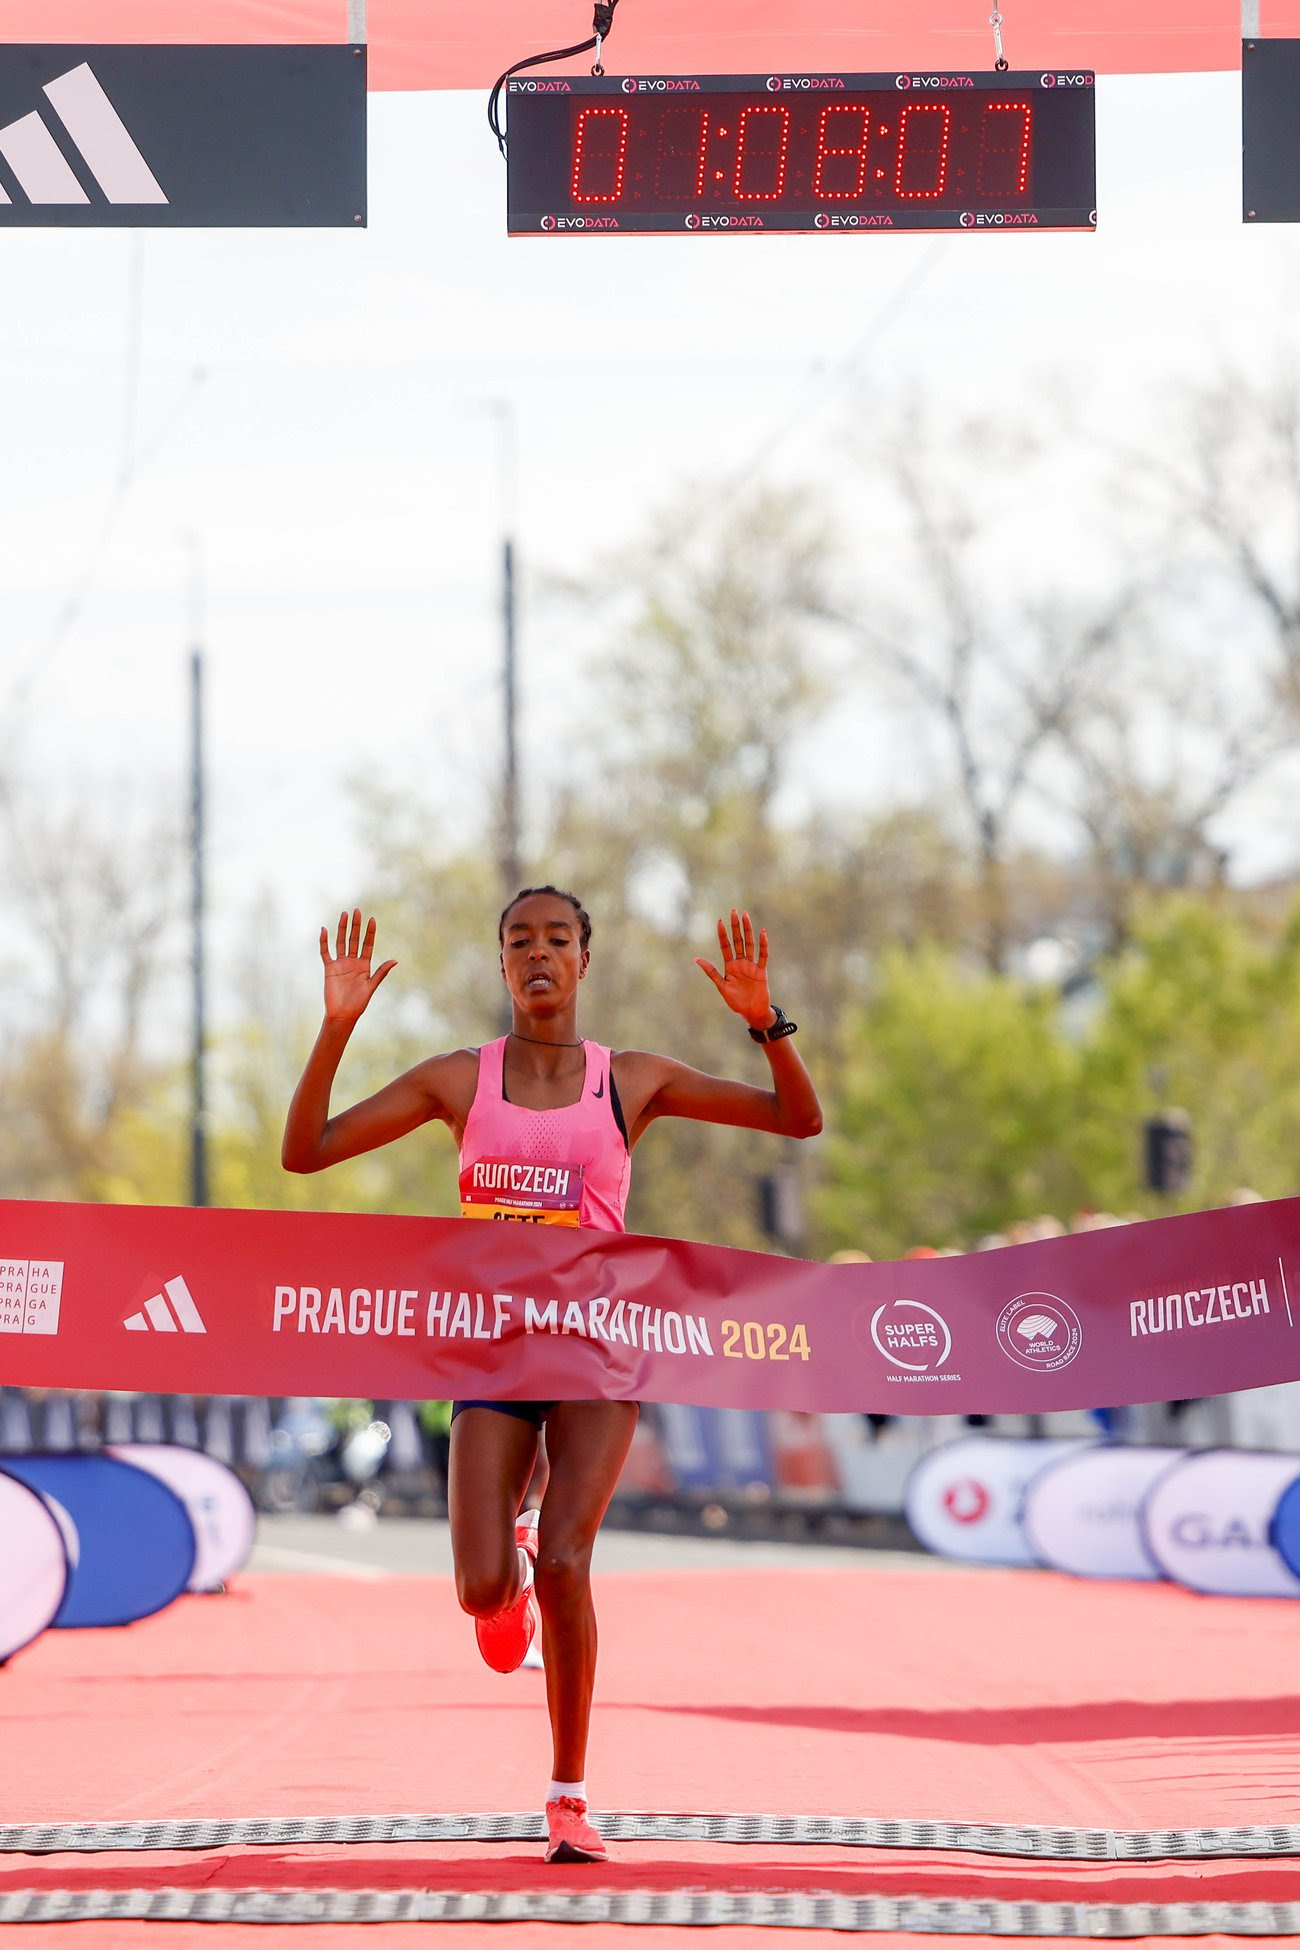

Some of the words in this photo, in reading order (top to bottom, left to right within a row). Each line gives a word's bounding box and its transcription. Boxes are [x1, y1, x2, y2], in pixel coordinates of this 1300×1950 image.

[508, 81, 572, 93] EVODATA
[637, 79, 701, 91] EVODATA
[782, 77, 845, 89] EVODATA
[911, 76, 975, 88] EVODATA
[556, 216, 620, 228] EVODATA
[701, 215, 764, 227] EVODATA
[830, 214, 894, 226] EVODATA
[976, 213, 1039, 225] EVODATA
[472, 1162, 570, 1196] RUNCZECH
[0, 1266, 25, 1277] PRA
[32, 1267, 50, 1278] HA
[30, 1283, 58, 1295] GUE
[28, 1299, 47, 1310] GA
[1130, 1278, 1271, 1337] RUNCZECH
[0, 1314, 20, 1325] RA
[27, 1315, 36, 1326] G
[1000, 1315, 1009, 1332] ELITE
[1006, 1300, 1026, 1316] LABEL
[272, 1285, 419, 1336] PRAGUE
[426, 1290, 513, 1339] HALF
[524, 1296, 715, 1356] MARATHON
[721, 1319, 812, 1361] 2024
[884, 1323, 936, 1336] SUPER
[887, 1335, 939, 1348] HALFS
[1028, 1340, 1054, 1348] WORLD
[1025, 1345, 1061, 1354] ATHLETICS
[1046, 1358, 1064, 1369] ROAD
[1063, 1346, 1077, 1361] RACE
[939, 1374, 962, 1382] SERIES
